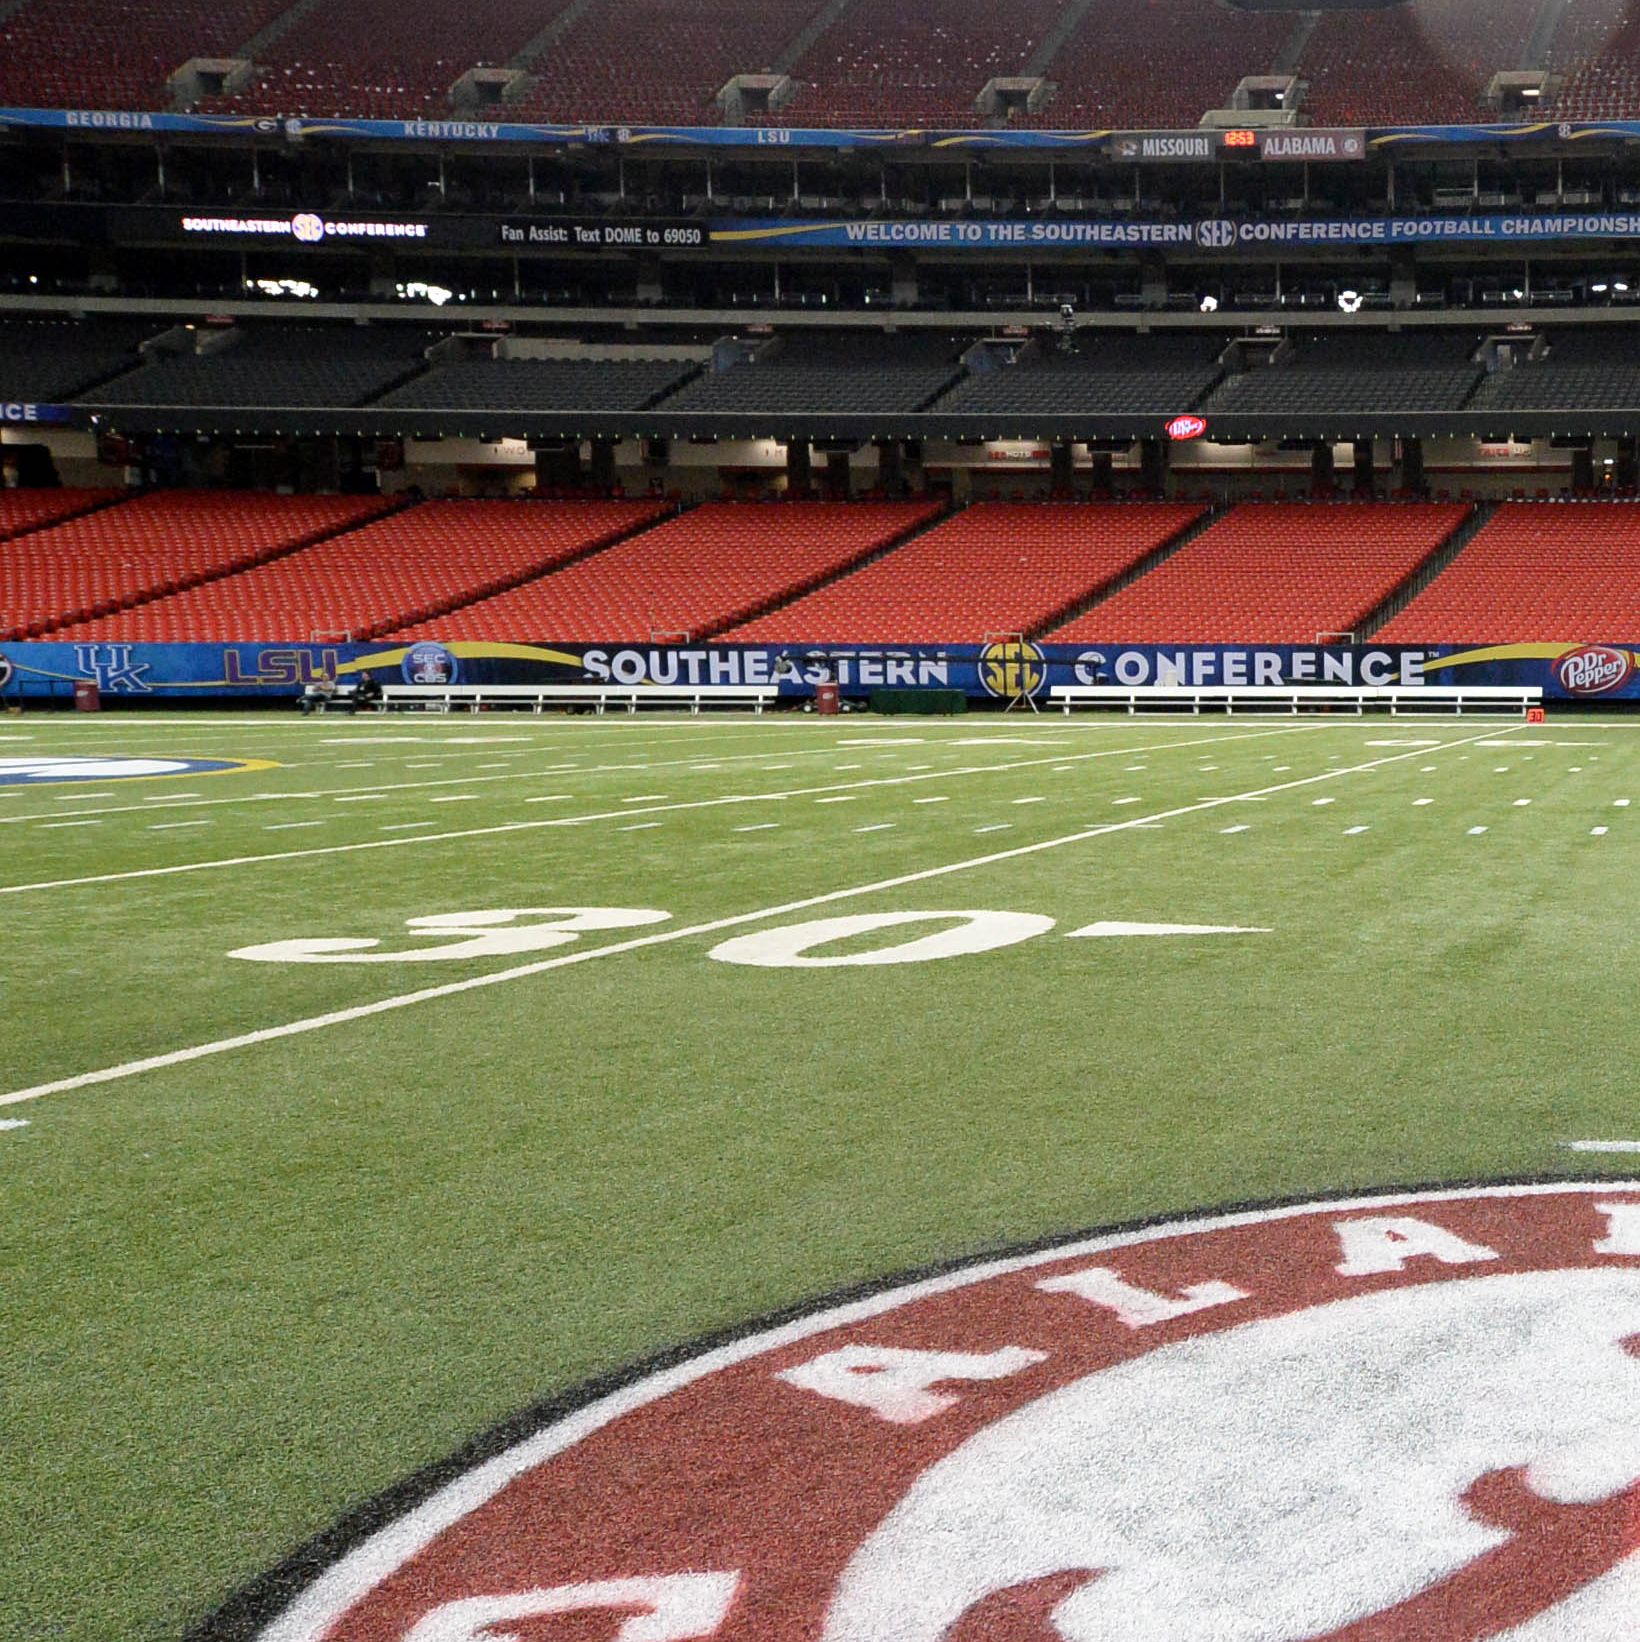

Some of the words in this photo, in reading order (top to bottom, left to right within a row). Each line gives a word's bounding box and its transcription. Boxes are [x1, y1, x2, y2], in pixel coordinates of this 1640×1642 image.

[65, 112, 153, 129] GEORGIA
[404, 122, 500, 138] KENTUCKY
[757, 130, 790, 144] LSU
[1142, 137, 1209, 157] MISSOURI
[1264, 136, 1336, 156] ALABAMA
[181, 217, 291, 234] SOUTHEASTERN
[325, 221, 424, 237] CONFERENCE
[502, 224, 524, 242] Fan
[529, 225, 568, 242] Assist:
[574, 226, 600, 243] Text
[605, 228, 642, 244] DOME
[647, 230, 660, 243] to
[664, 229, 701, 245] 69050
[846, 223, 951, 241] WELCOME
[958, 224, 982, 241] TO
[988, 224, 1026, 241] THE
[1032, 224, 1193, 242] SOUTHEASTERN
[1239, 222, 1385, 241] CONFERENCE
[1392, 219, 1495, 238] FOOTBALL
[223, 649, 338, 686] LSU
[412, 653, 446, 665] SEC
[581, 650, 948, 686] SOUTHEASTERN
[1584, 652, 1607, 669] Dr
[413, 673, 447, 685] CBS
[1567, 656, 1622, 691] Pepper
[1528, 710, 1543, 723] 30
